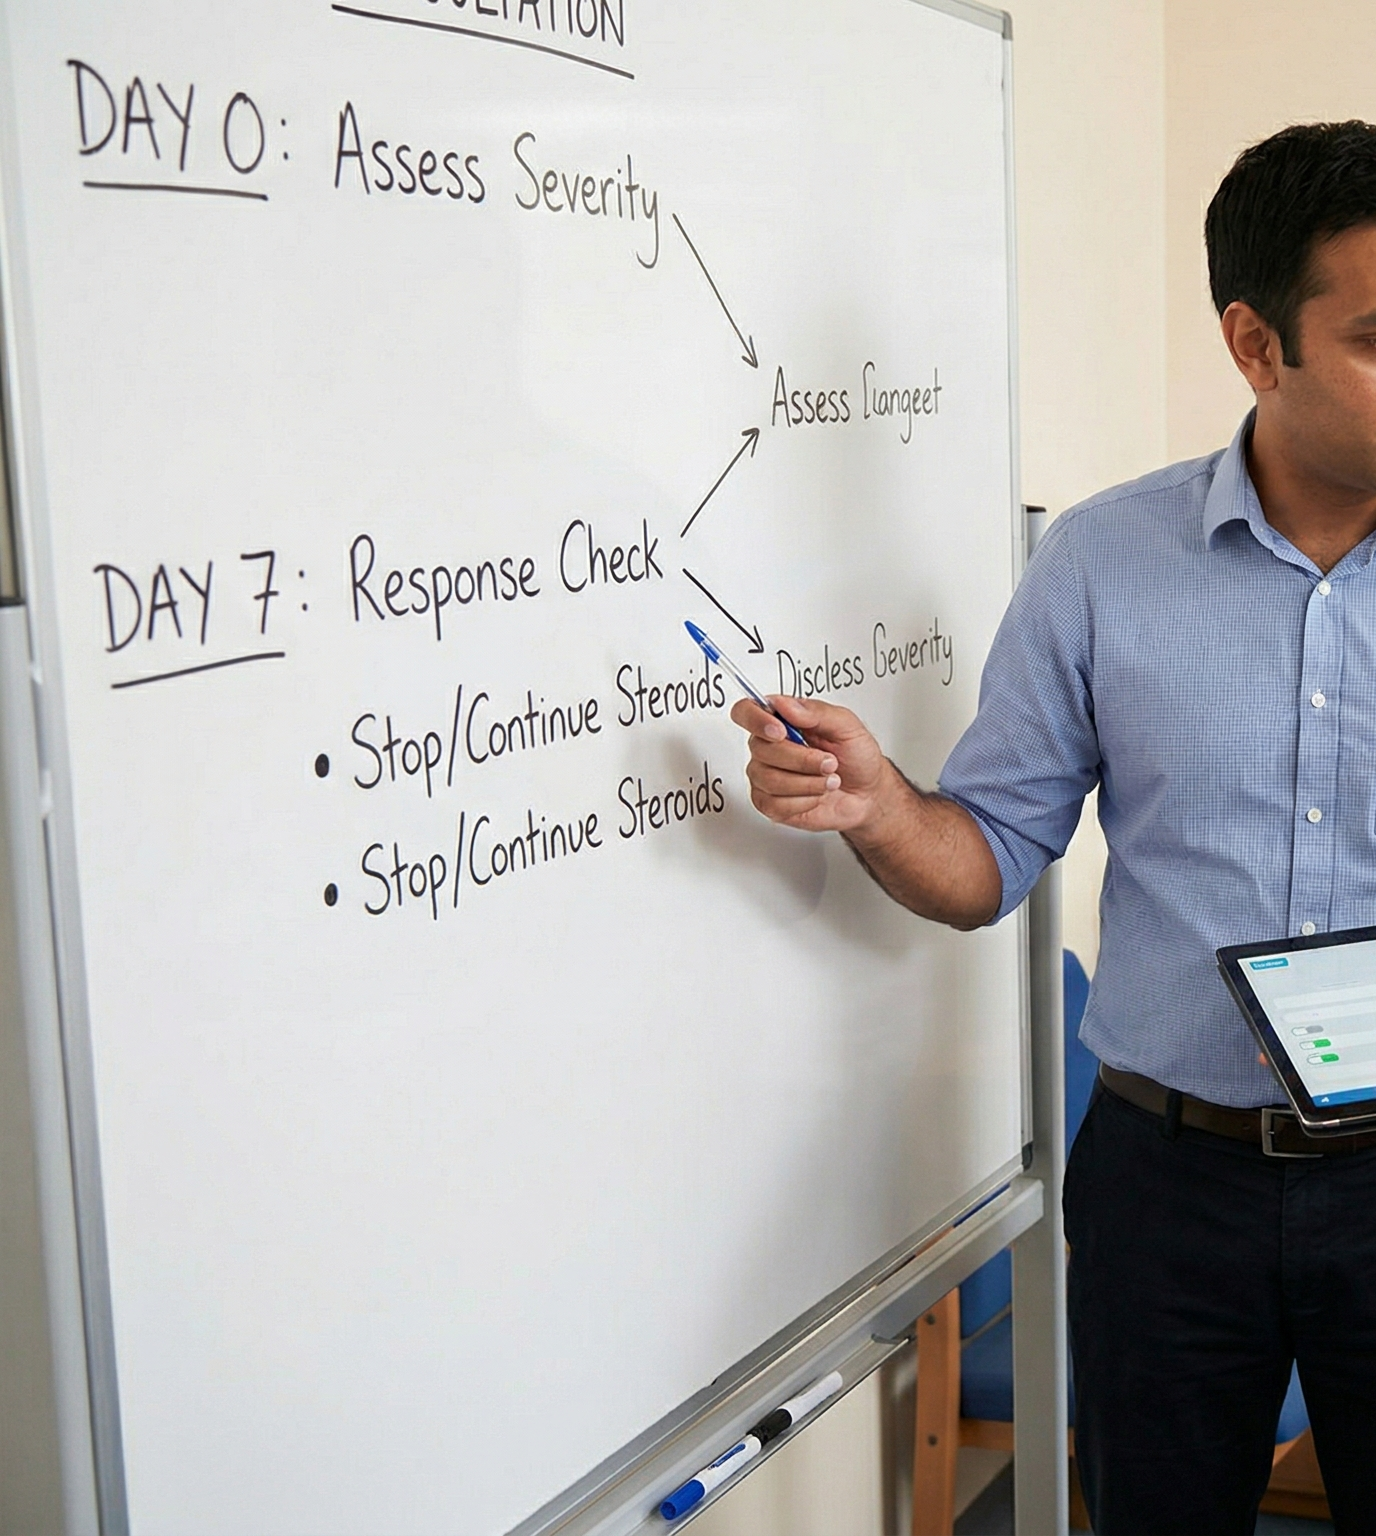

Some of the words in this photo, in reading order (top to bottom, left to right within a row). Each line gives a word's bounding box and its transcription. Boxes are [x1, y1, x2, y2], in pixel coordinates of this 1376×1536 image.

[66, 59, 194, 172] DAY
[334, 101, 486, 203] Assess
[514, 132, 660, 269] Severity
[771, 366, 851, 428] Assess
[93, 561, 214, 653] DAY
[350, 534, 541, 641] Response
[560, 518, 664, 593] Check
[351, 684, 603, 798] Stop/Continue
[616, 655, 726, 727] Steroids
[776, 644, 865, 699] Discless
[361, 811, 604, 920] Stop/Continue
[618, 761, 726, 838] Steroids
